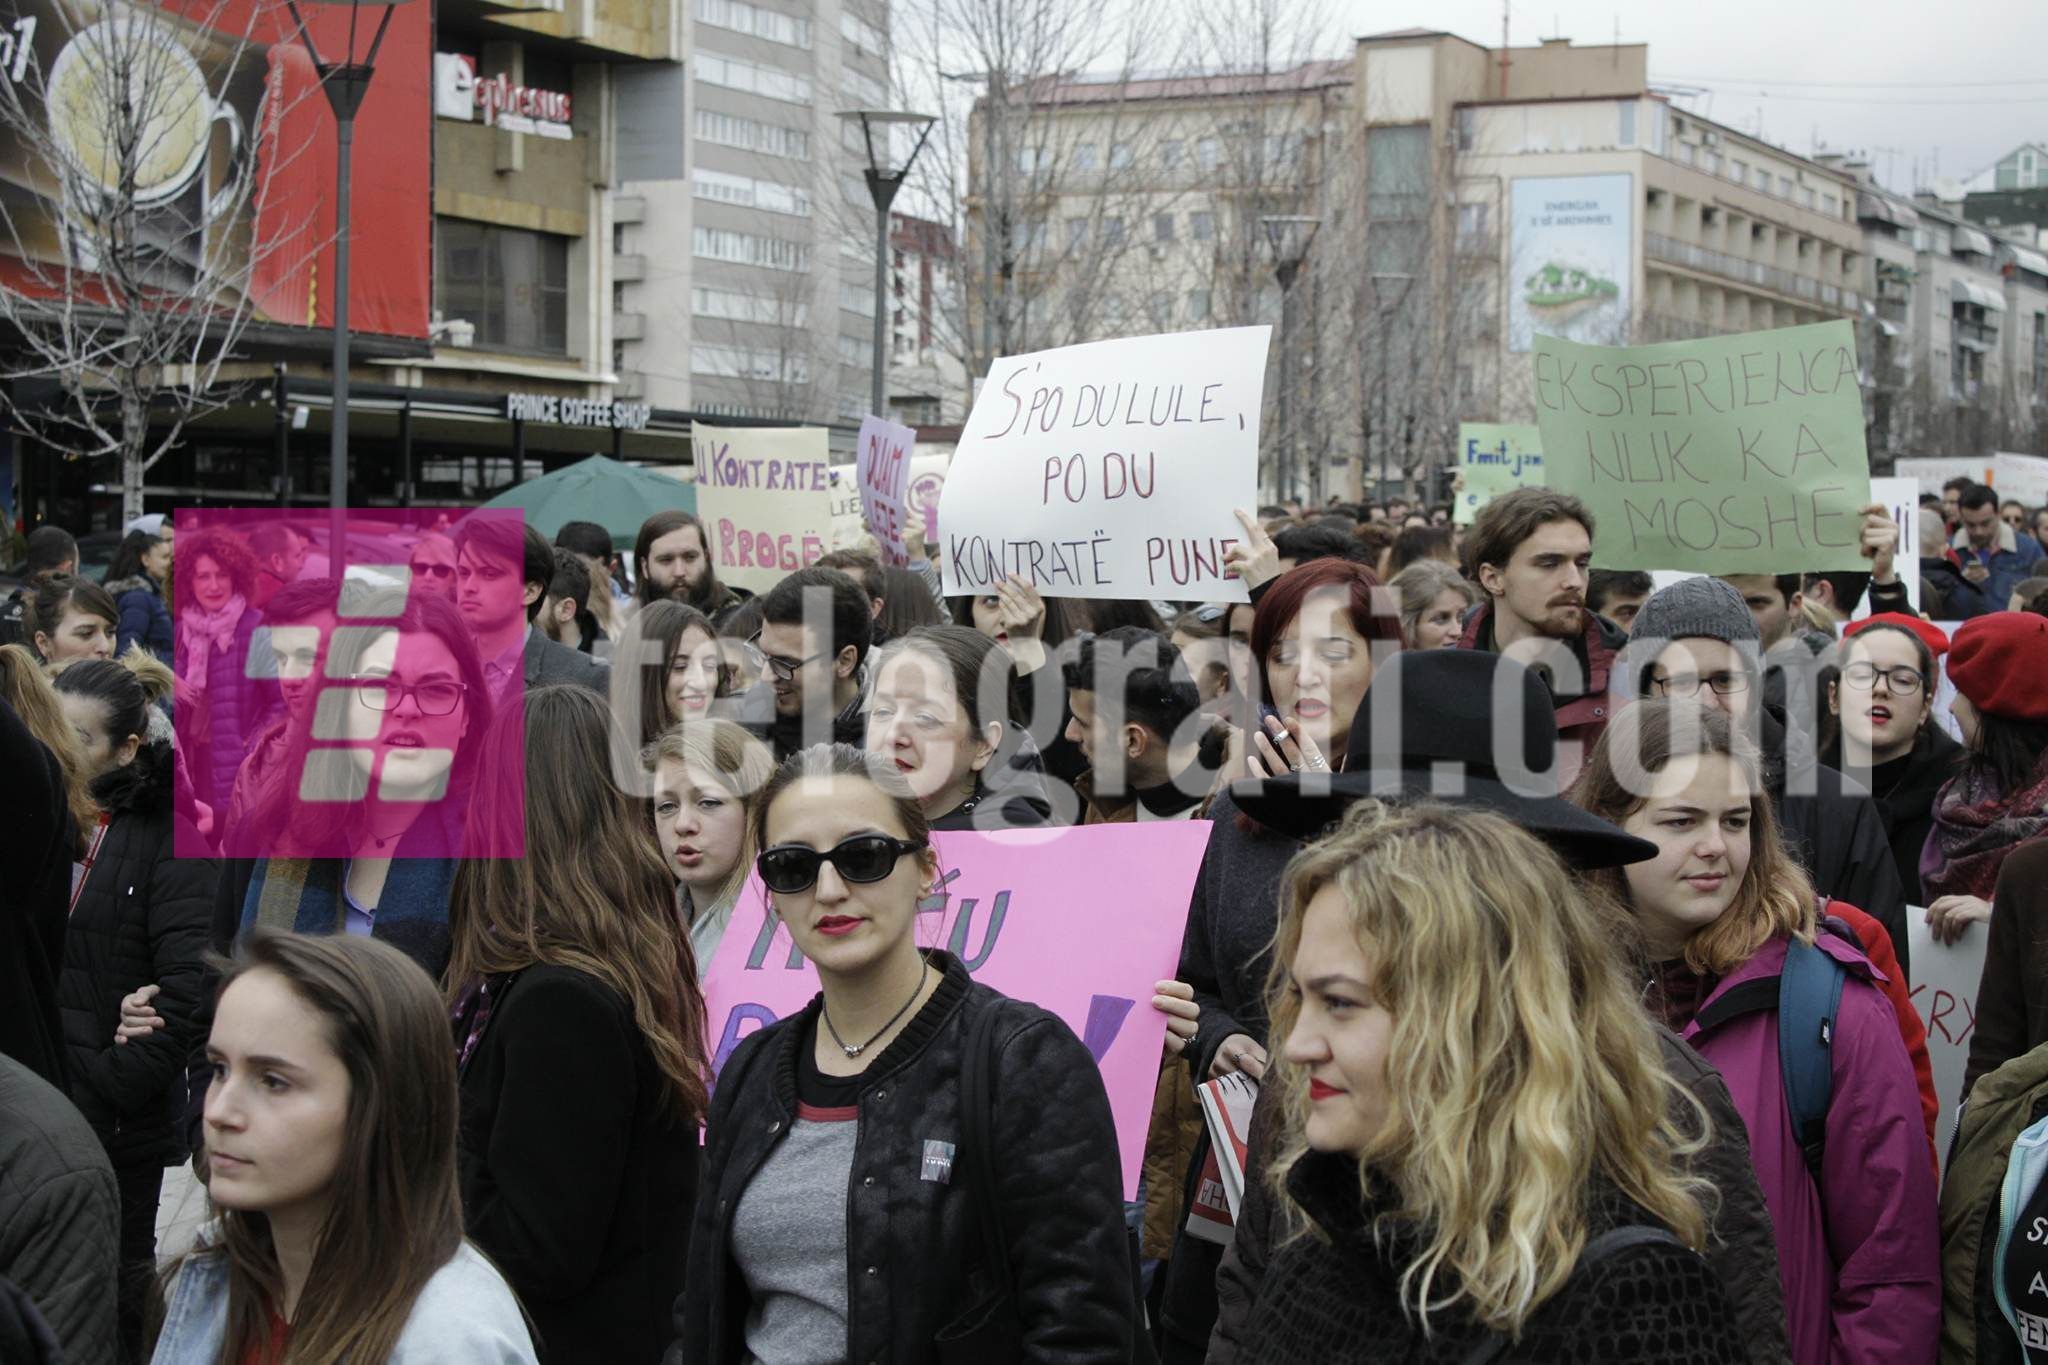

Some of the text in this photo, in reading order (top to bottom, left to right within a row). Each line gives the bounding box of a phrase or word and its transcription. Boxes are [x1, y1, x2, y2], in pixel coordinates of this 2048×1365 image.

[1537, 345, 1859, 416] EKSPERIENCA
[507, 392, 650, 430] PRINCE COFFEE SHOP
[1043, 452, 1154, 505] PO DU
[1586, 428, 1709, 484] NUK
[951, 529, 1112, 588] KONTRATË
